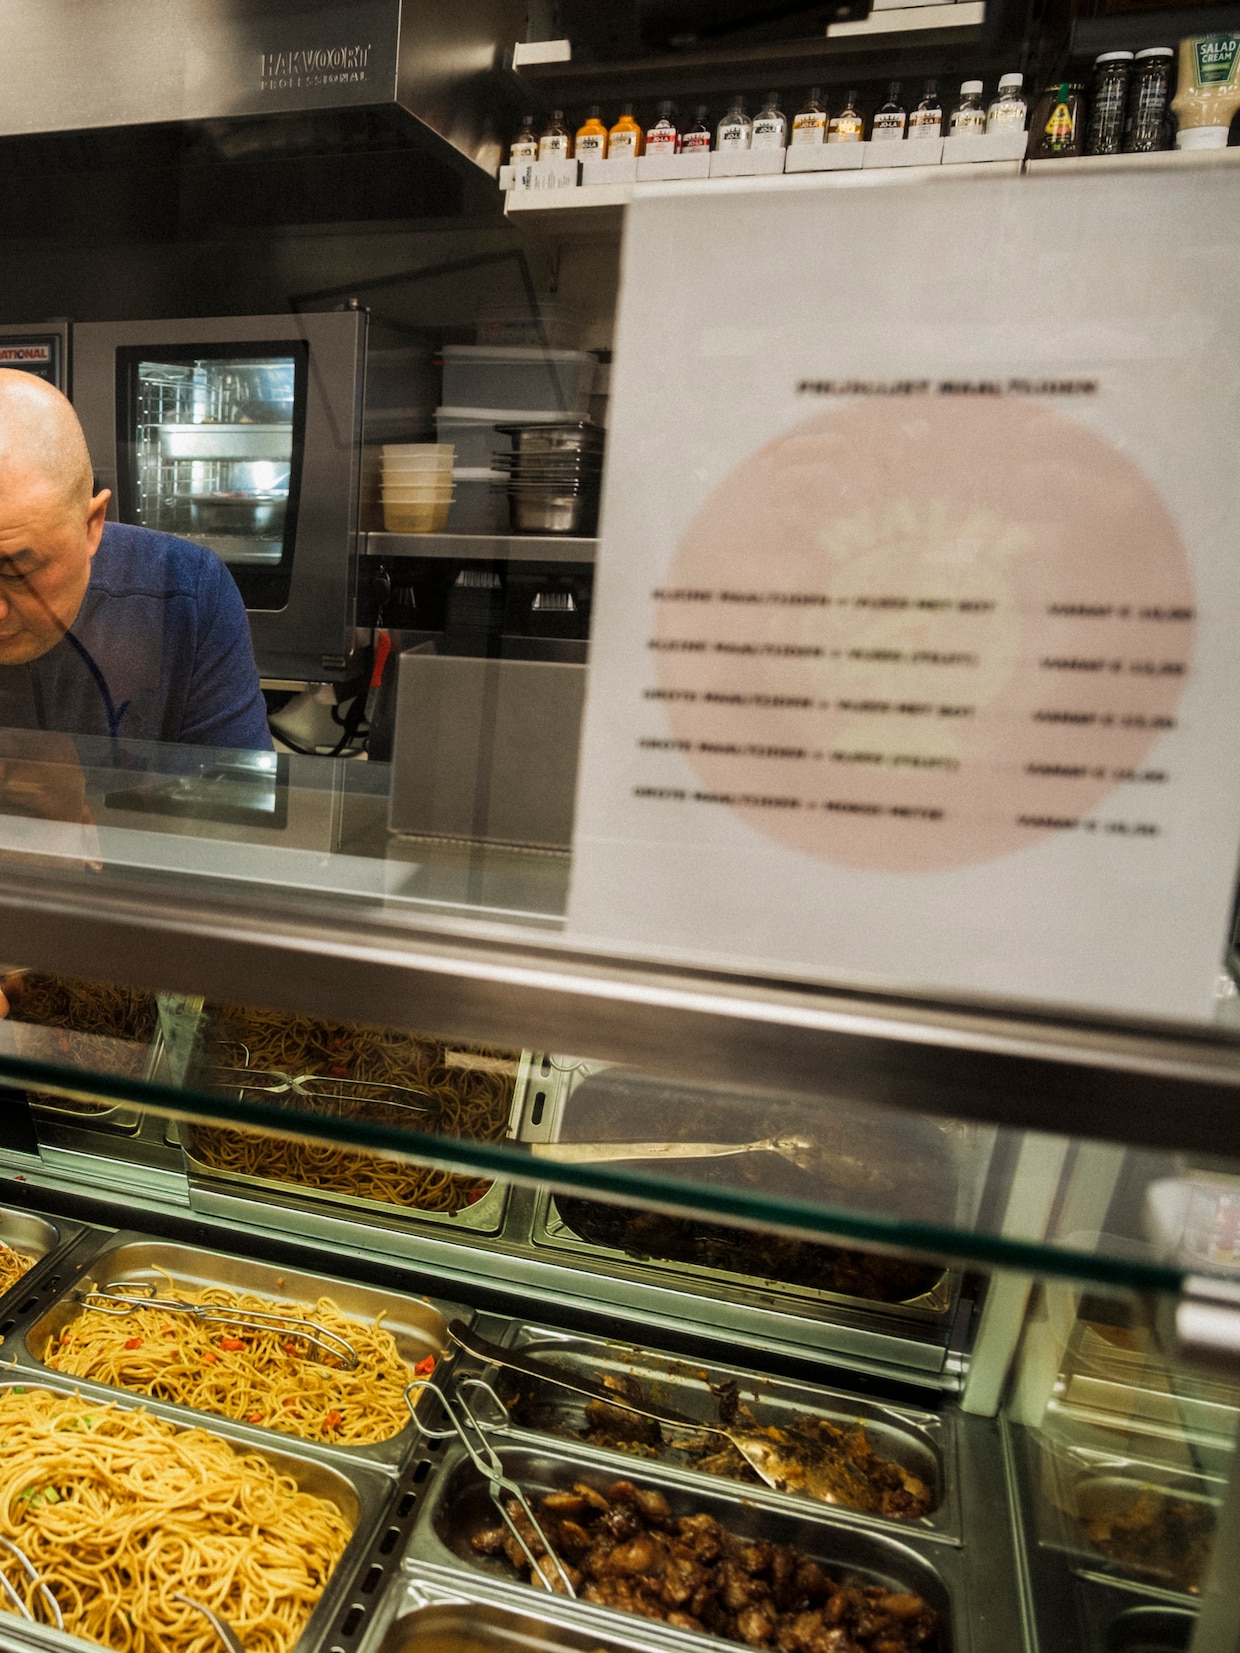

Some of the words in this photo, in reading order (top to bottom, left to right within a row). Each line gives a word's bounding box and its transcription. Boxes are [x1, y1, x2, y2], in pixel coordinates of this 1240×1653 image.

[1200, 41, 1237, 55] SALAD
[261, 44, 371, 77] HAKVOORT
[1201, 51, 1232, 63] CREAM
[260, 71, 368, 91] PROFESSIONAL
